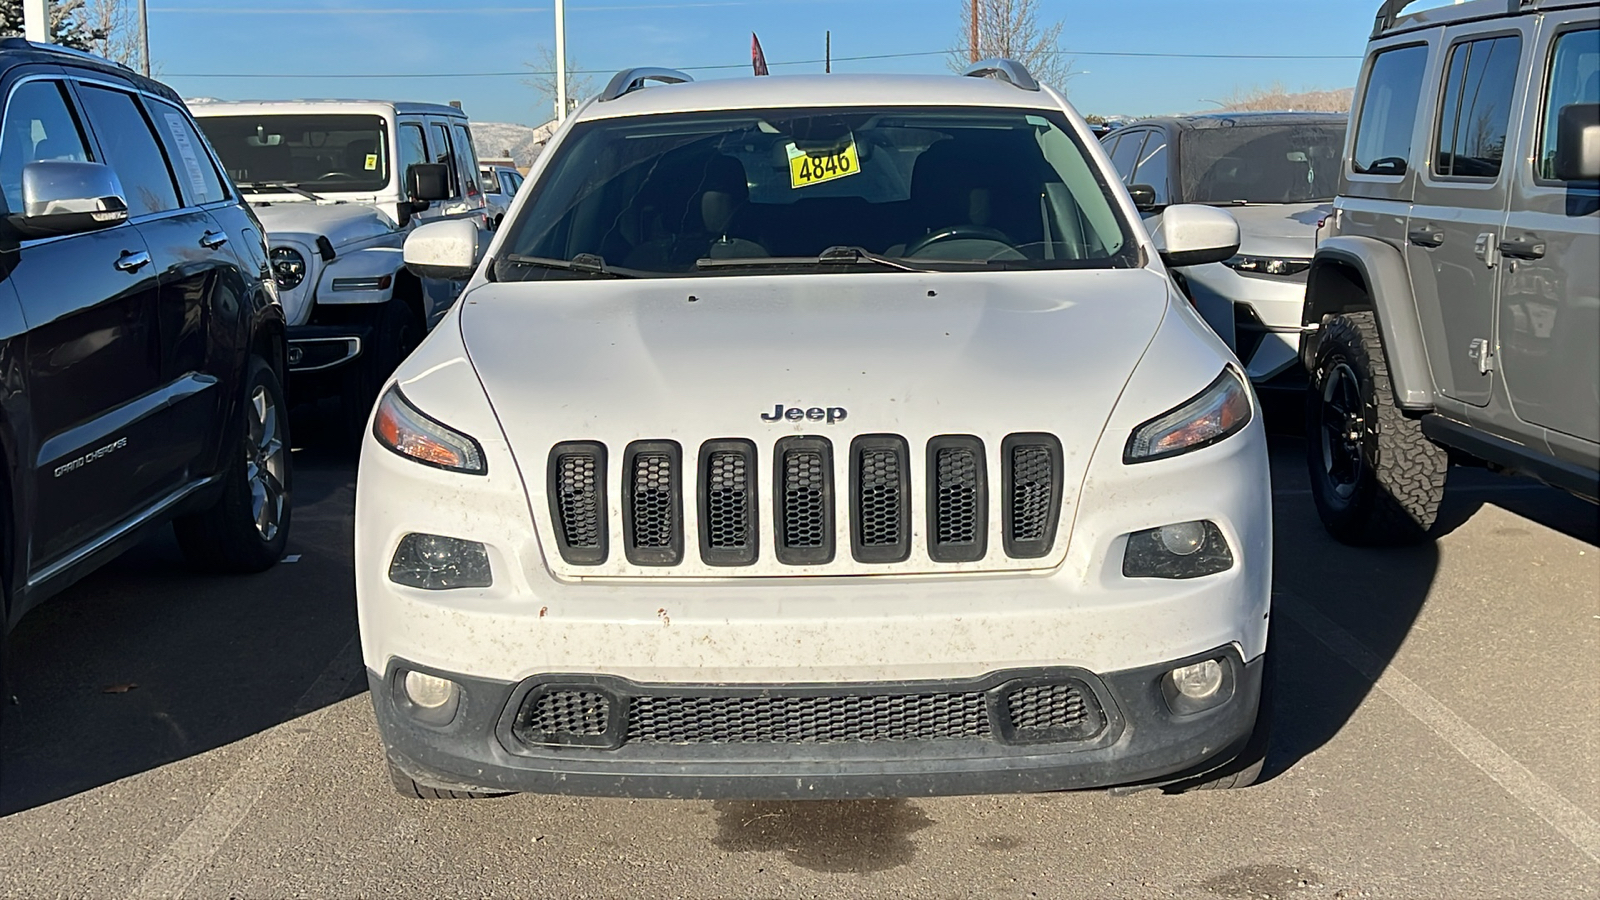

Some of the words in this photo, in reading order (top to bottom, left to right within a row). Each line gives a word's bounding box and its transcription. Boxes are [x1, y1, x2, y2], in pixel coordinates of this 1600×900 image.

[799, 151, 850, 181] 4846
[761, 404, 848, 424] Jeep
[54, 457, 84, 477] GRAND
